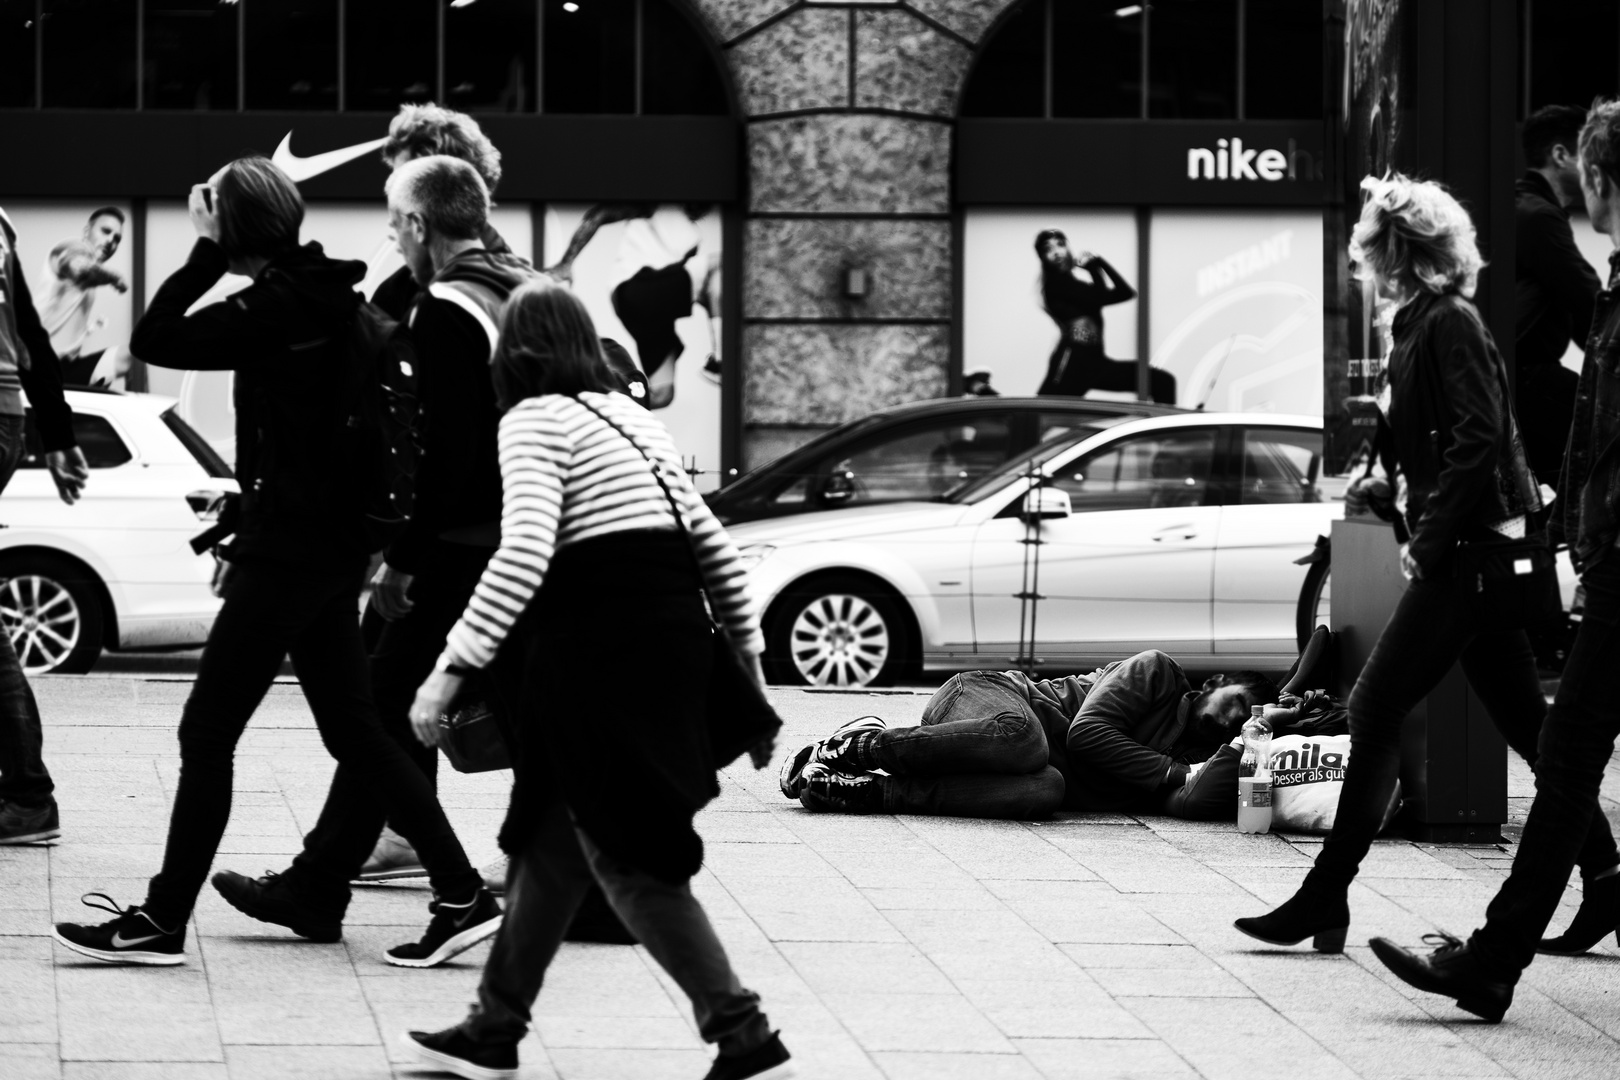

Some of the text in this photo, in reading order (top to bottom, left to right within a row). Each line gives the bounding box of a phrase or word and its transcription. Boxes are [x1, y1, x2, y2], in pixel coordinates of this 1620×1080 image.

[1197, 229, 1293, 297] INSTANT
[1271, 743, 1343, 770] mila
[1273, 768, 1346, 786] besser als gut
